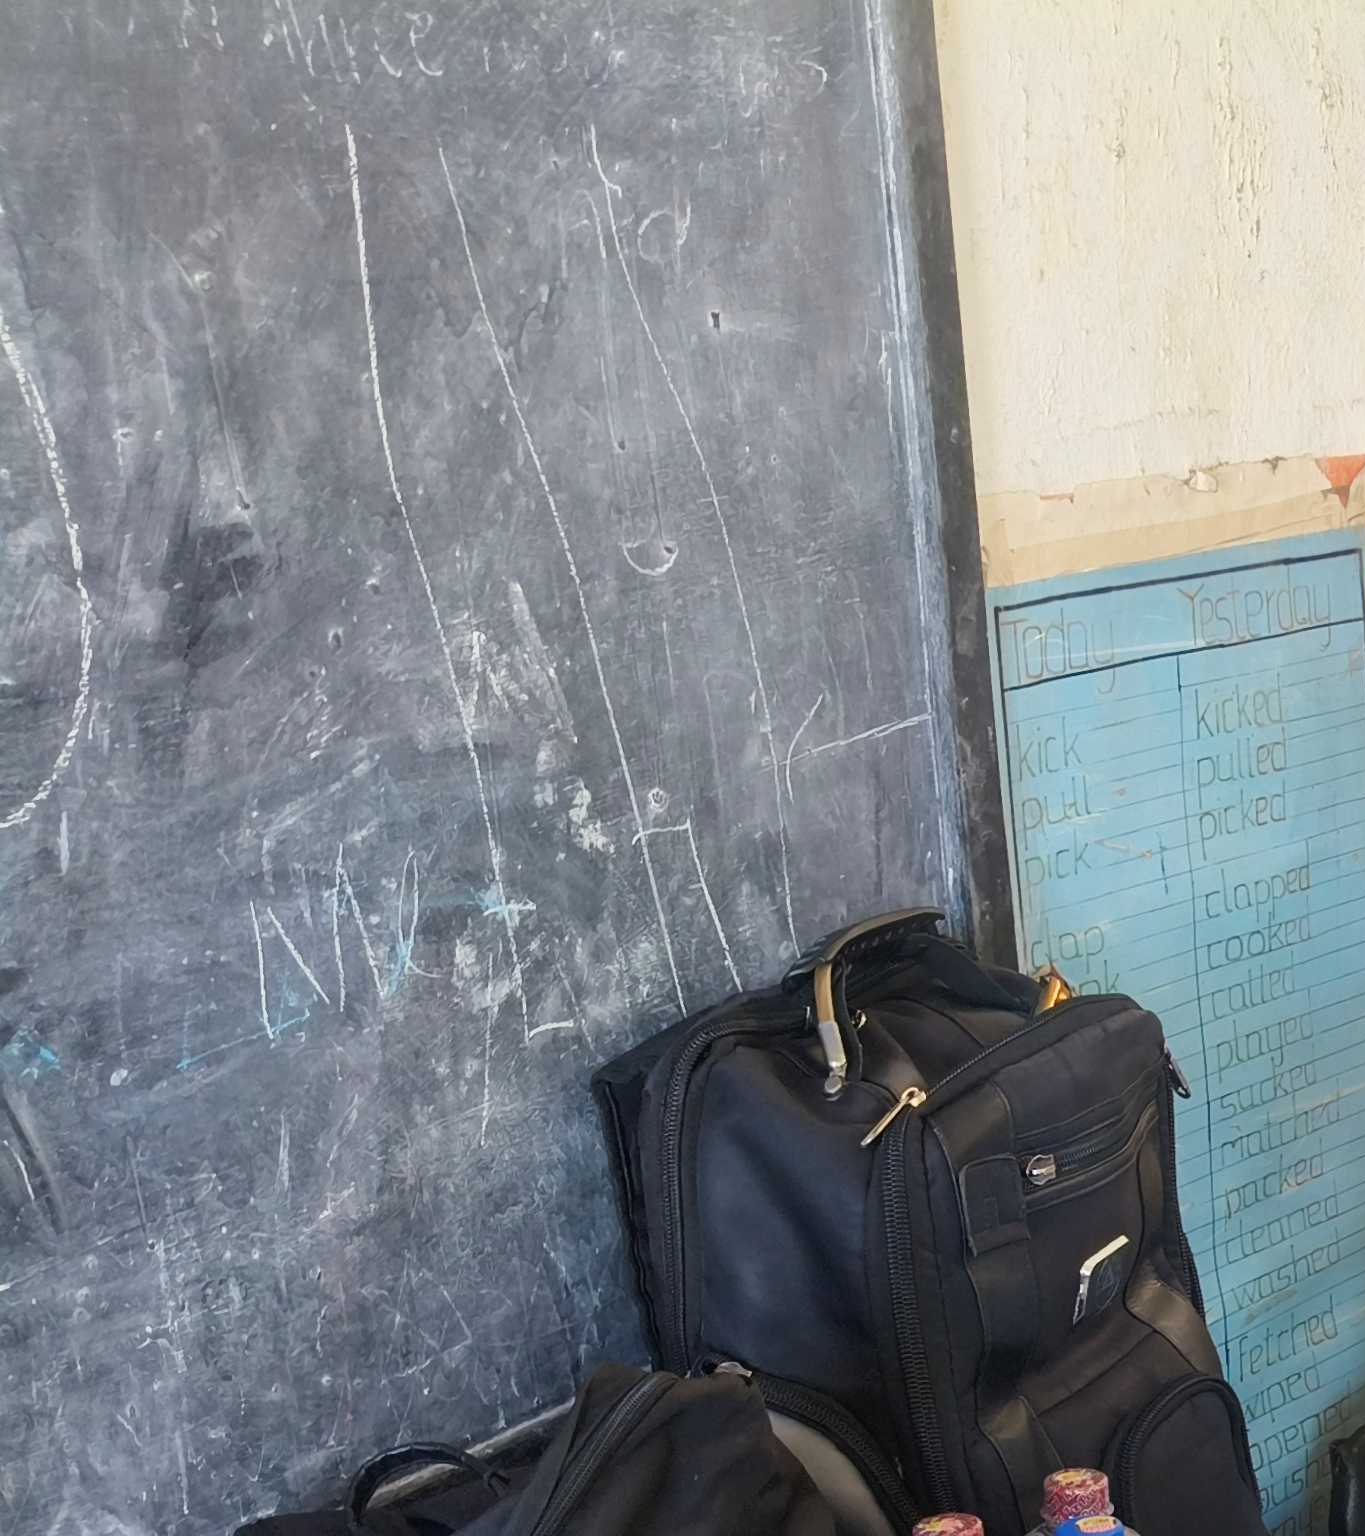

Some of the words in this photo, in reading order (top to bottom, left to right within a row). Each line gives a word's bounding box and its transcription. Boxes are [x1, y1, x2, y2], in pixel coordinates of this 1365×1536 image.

[1001, 608, 1116, 693] Today
[1177, 567, 1333, 651] Yesterday
[1195, 673, 1284, 740] kicked
[1015, 716, 1082, 782] kick
[1197, 726, 1287, 804] pulled
[1021, 775, 1093, 850] pull
[1199, 789, 1286, 860] picked
[1025, 839, 1093, 916] pick
[1203, 838, 1312, 921] clapped
[1207, 900, 1311, 969] cooked
[1217, 988, 1315, 1082] played
[1221, 1078, 1343, 1166] matched
[1224, 1139, 1325, 1227] packed
[1224, 1184, 1340, 1265] cleaned
[1229, 1227, 1341, 1313] washed
